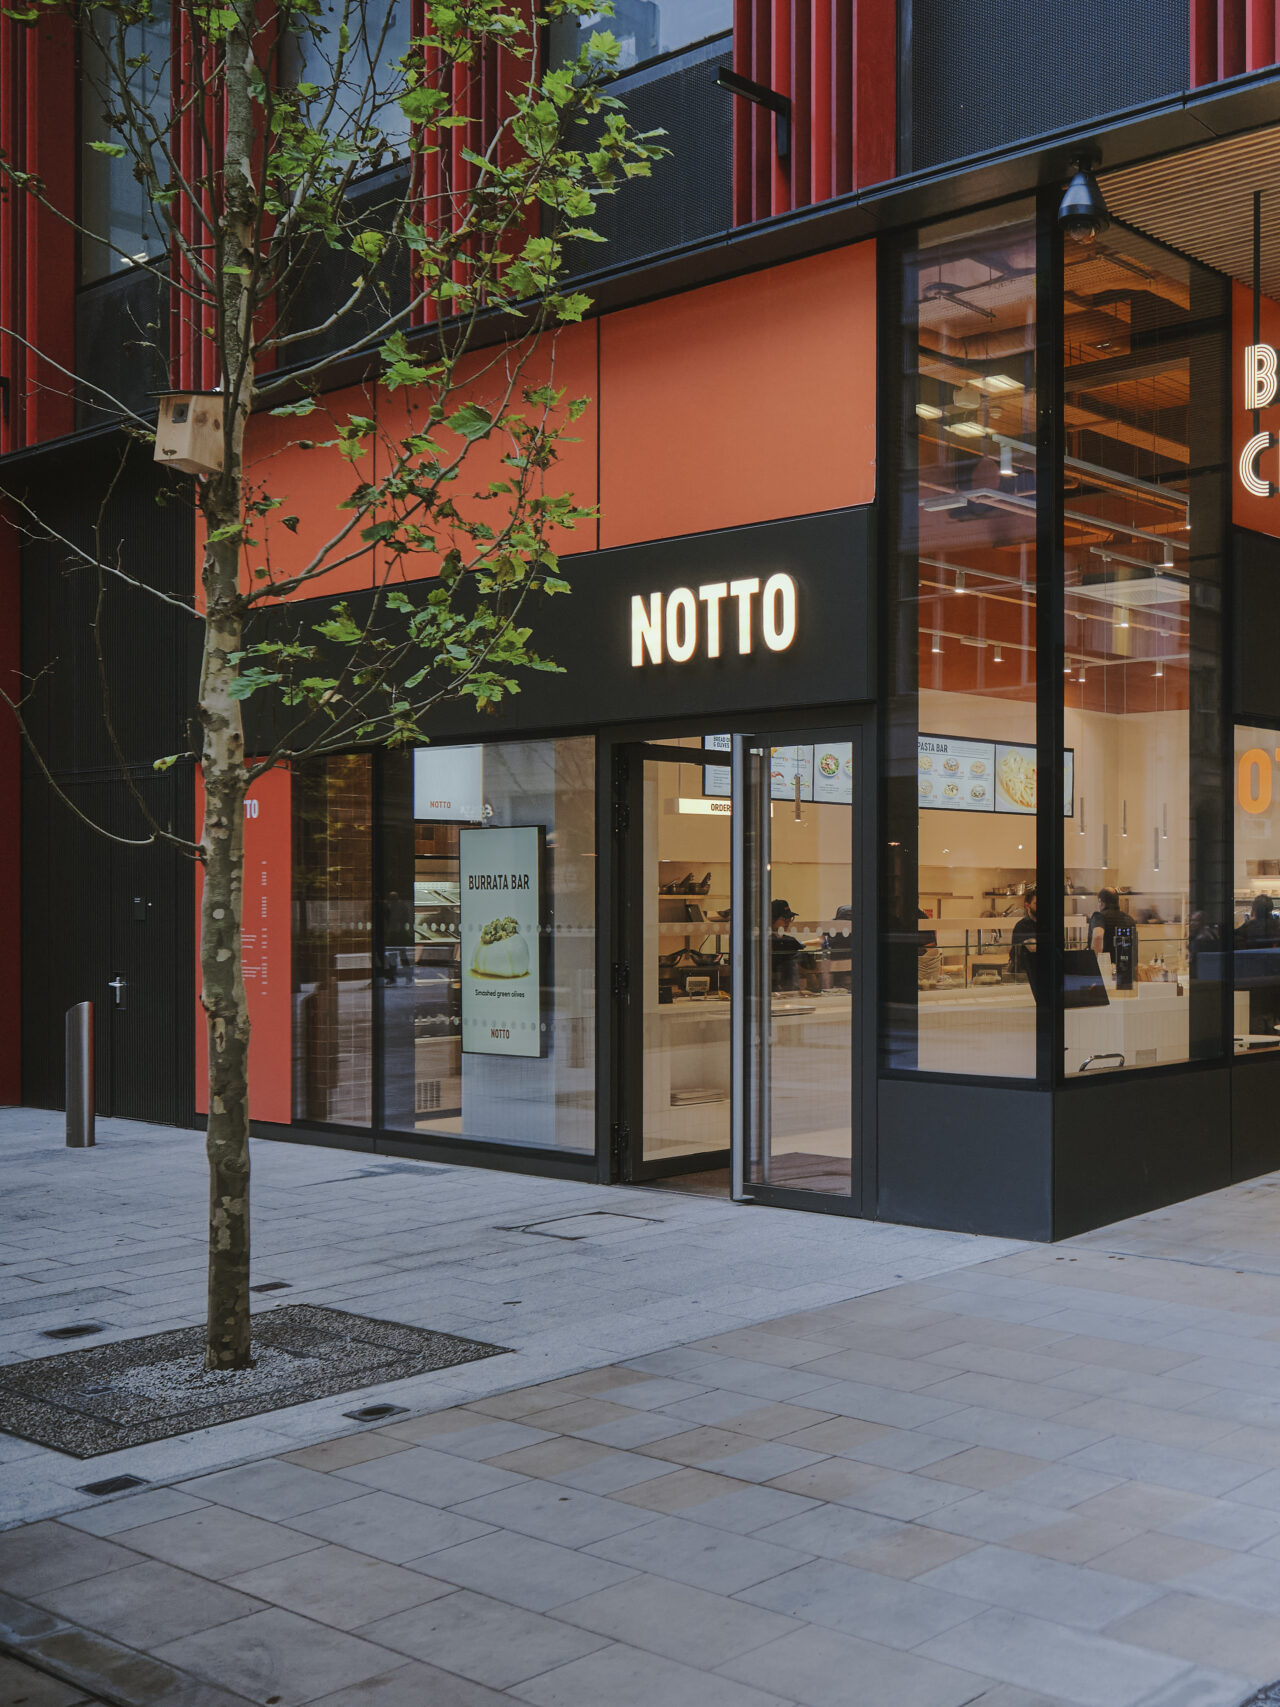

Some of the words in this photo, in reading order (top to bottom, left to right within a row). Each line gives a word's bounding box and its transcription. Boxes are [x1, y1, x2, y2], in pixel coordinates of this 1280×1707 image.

[631, 573, 796, 667] NOTTO
[917, 742, 935, 752] PASTA
[936, 743, 948, 753] BAR
[430, 800, 452, 809] NOTTO
[468, 874, 509, 890] BURRATA
[511, 874, 530, 890] BAR
[474, 989, 496, 997] Smashed
[497, 991, 511, 999] green
[511, 990, 525, 998] olives
[490, 1028, 510, 1039] NOTTO
